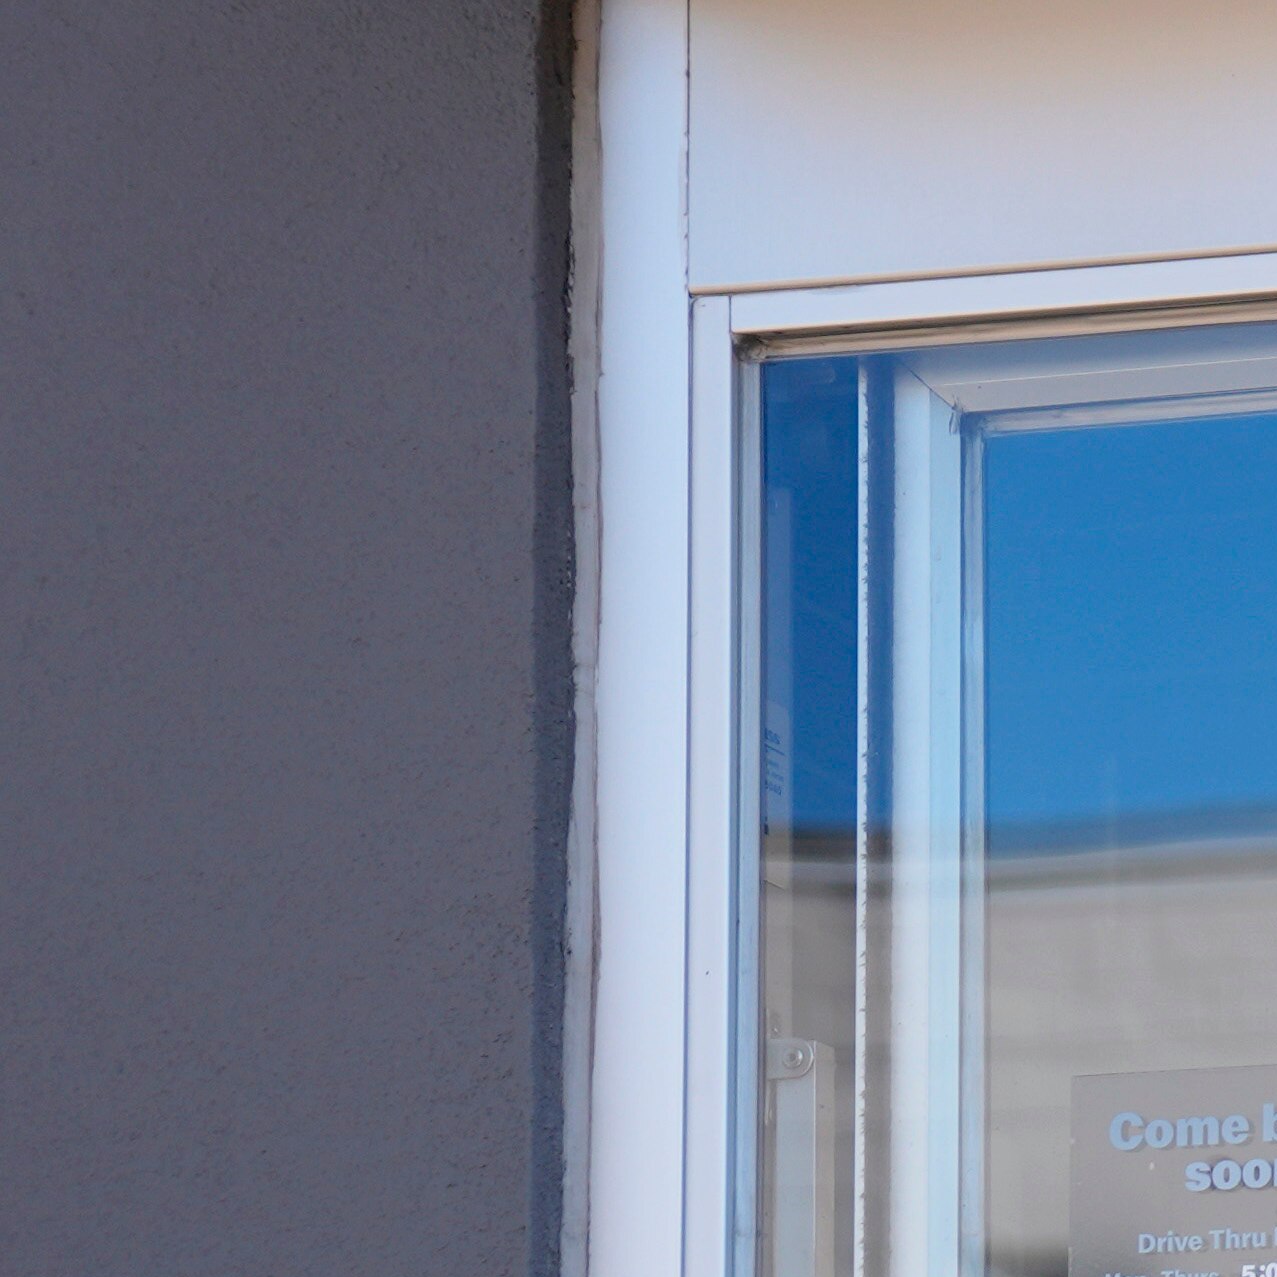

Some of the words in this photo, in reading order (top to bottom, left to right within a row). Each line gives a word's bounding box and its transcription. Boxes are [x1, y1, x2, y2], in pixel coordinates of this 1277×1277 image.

[1109, 1111, 1251, 1151] Come
[1137, 1233, 1202, 1254] Drive
[1209, 1229, 1266, 1250] Thru
